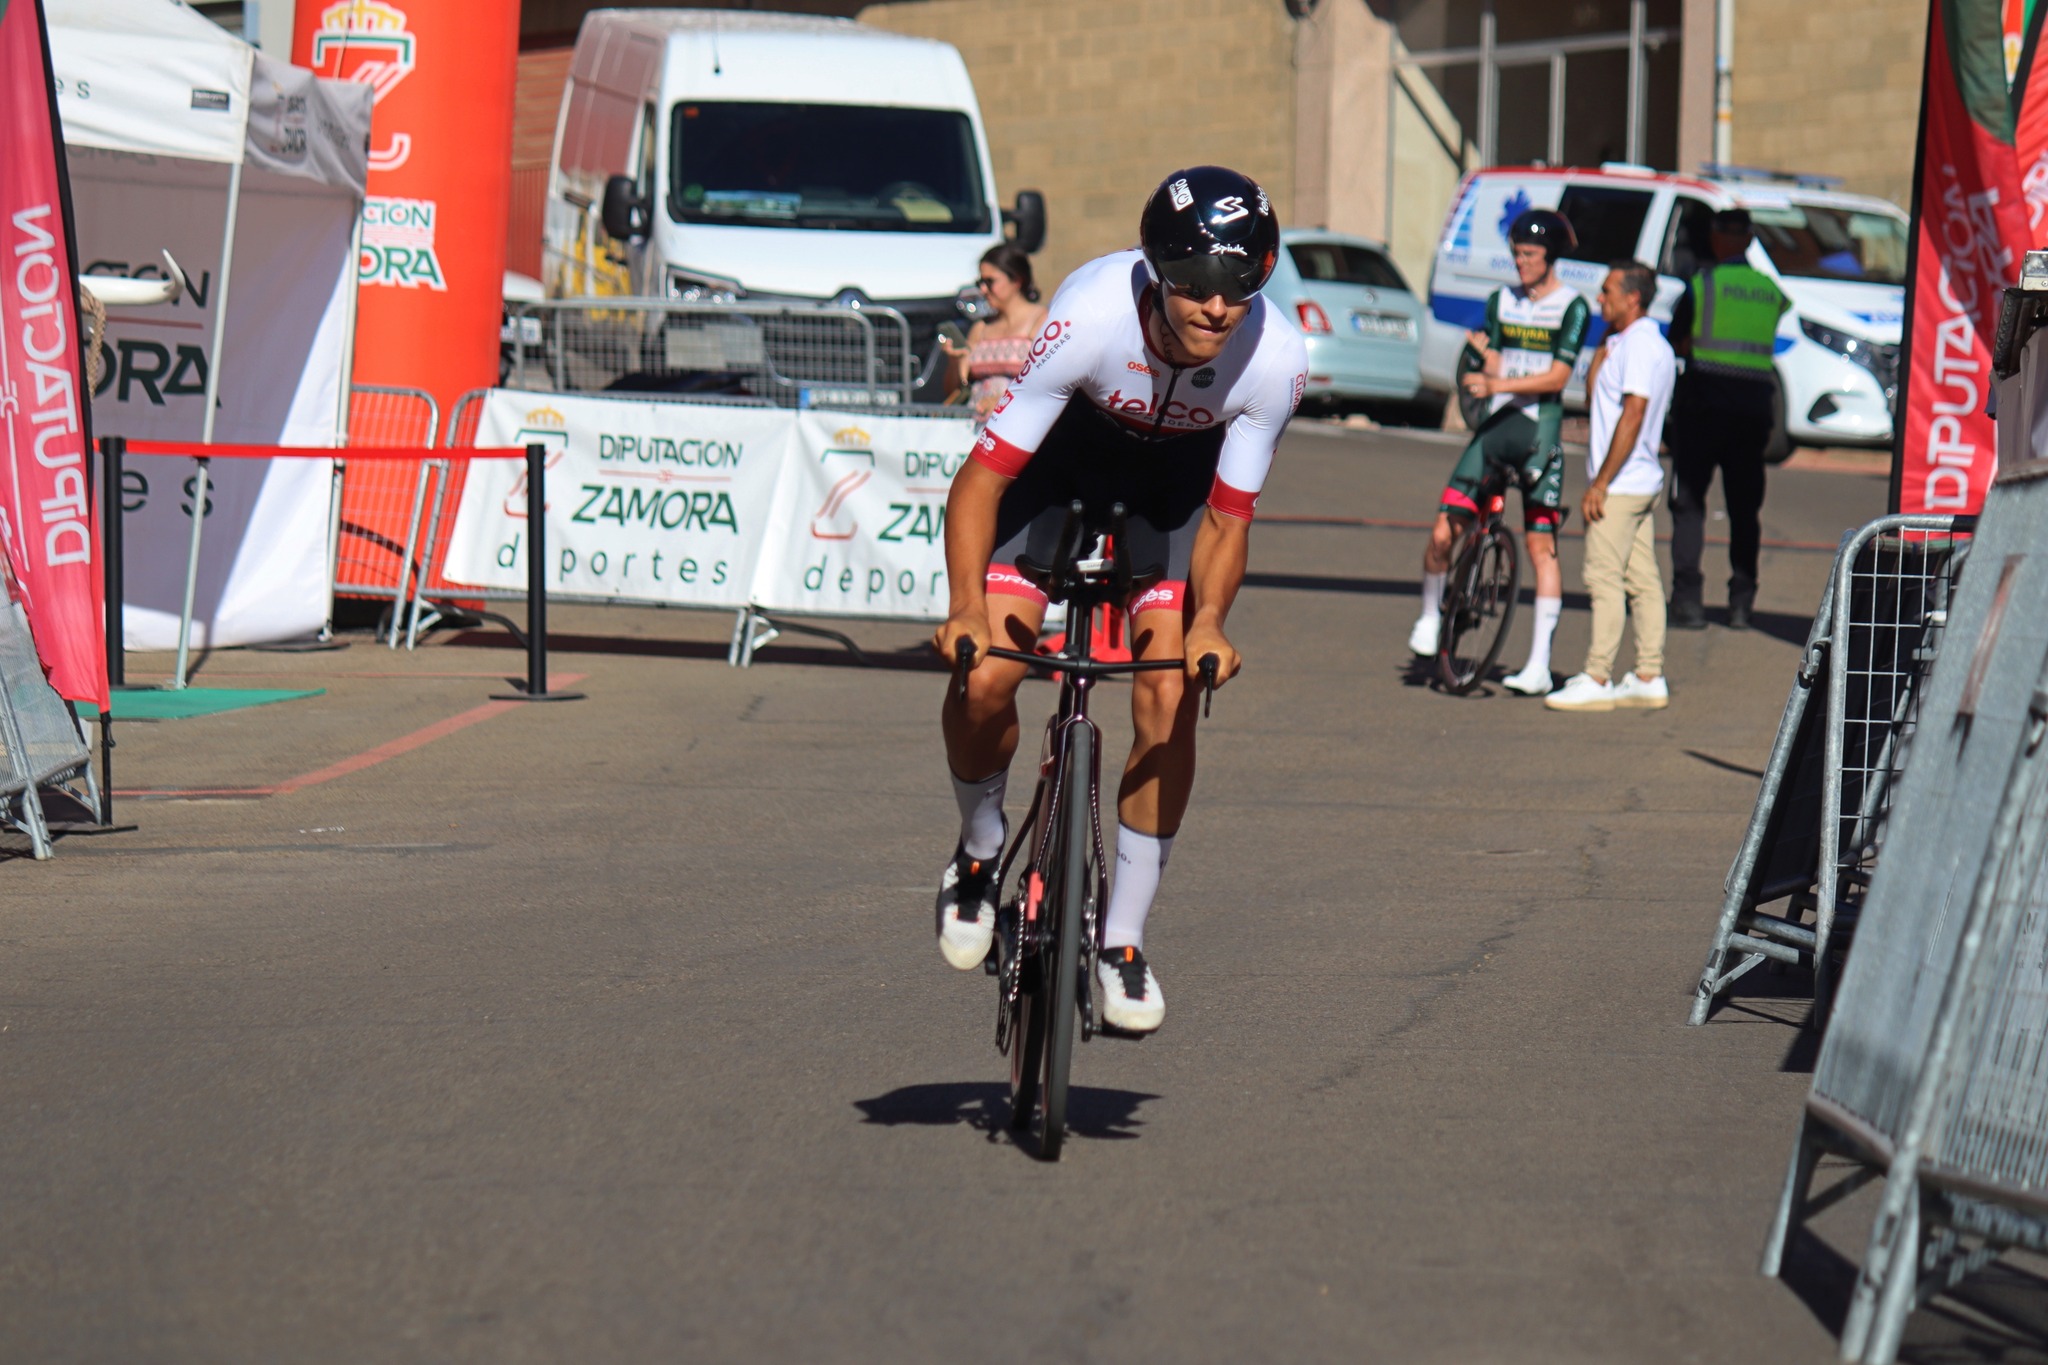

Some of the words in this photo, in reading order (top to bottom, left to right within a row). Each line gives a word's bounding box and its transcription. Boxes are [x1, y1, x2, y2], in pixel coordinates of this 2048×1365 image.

[1208, 243, 1248, 256] Spiuk
[1036, 333, 1071, 370] MADERAS
[599, 434, 743, 468] DIPUTACION
[571, 484, 739, 535] ZAMORA
[497, 533, 729, 585] dportes
